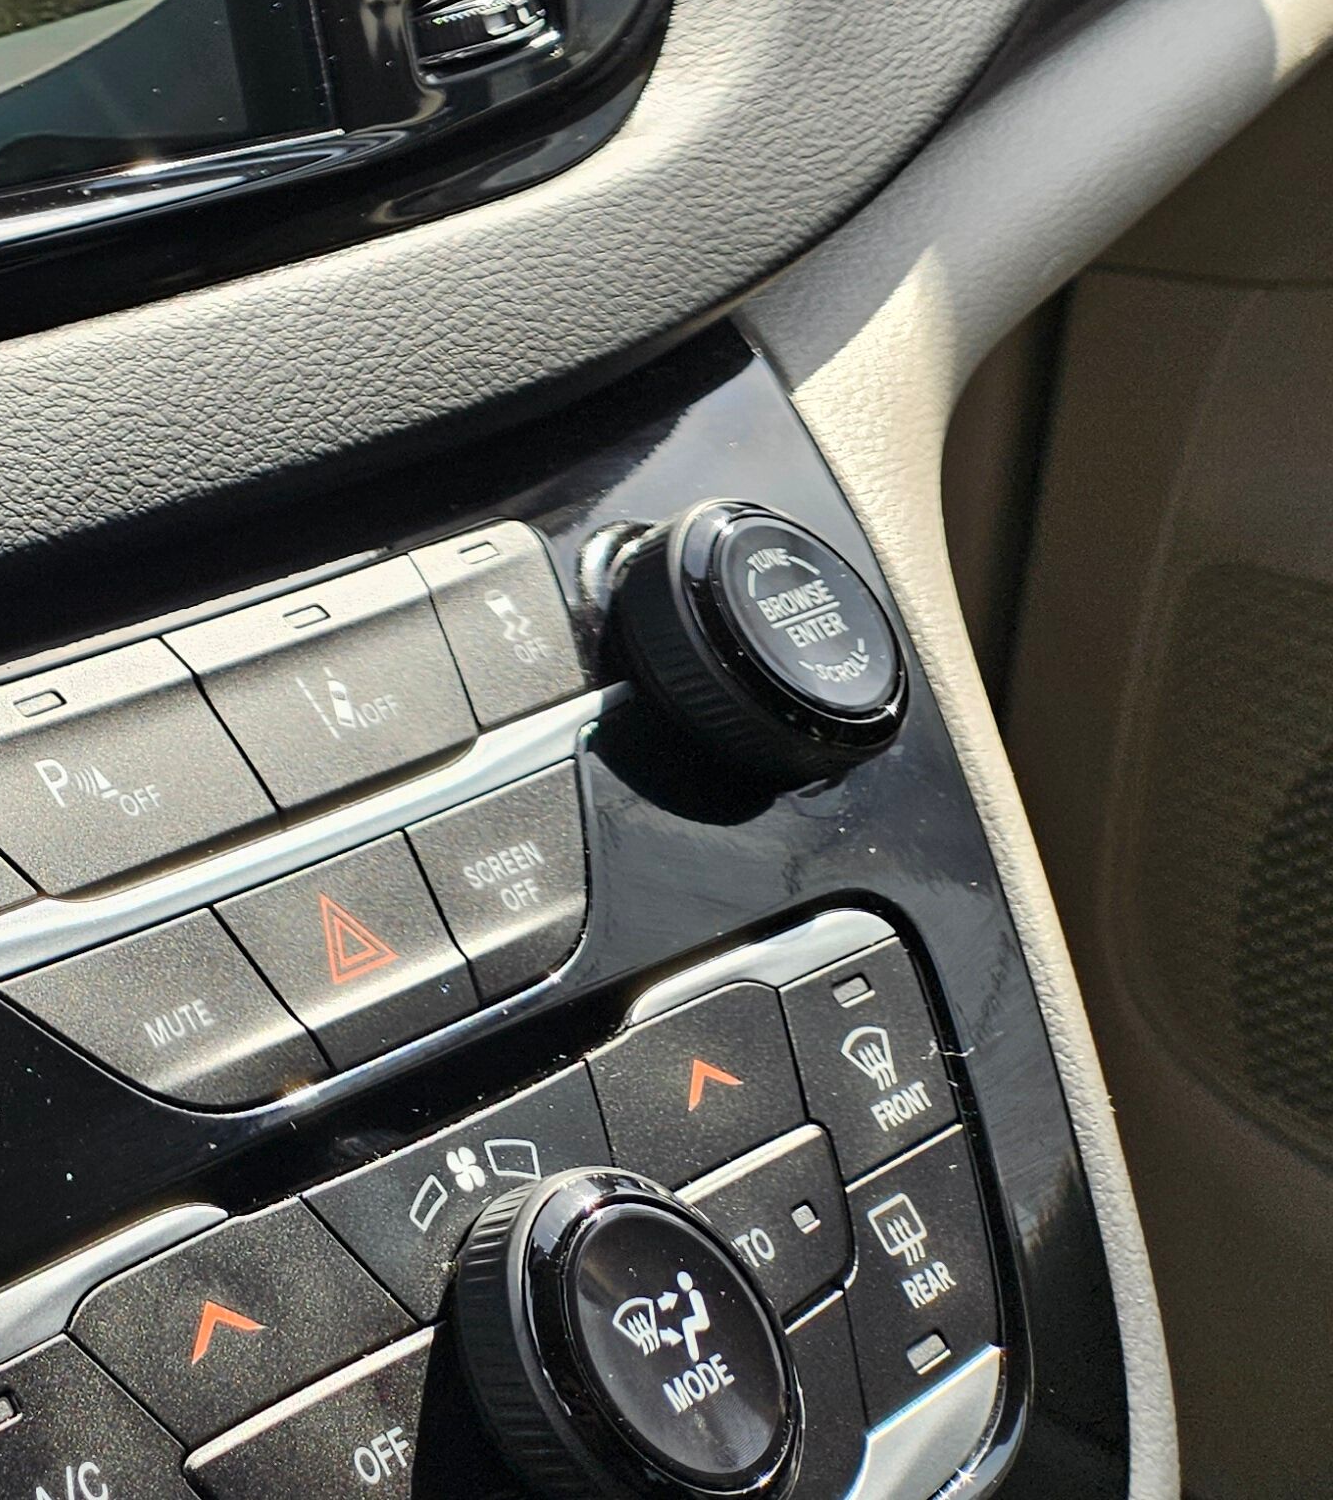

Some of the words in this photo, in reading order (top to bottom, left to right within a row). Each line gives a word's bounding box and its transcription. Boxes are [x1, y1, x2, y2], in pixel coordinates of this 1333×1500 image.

[746, 547, 792, 574] TUNE
[756, 578, 836, 623] BROWSE
[784, 611, 851, 649] ENTER
[513, 638, 550, 664] OFF
[813, 651, 870, 684] SCROLL
[364, 694, 399, 726] OFF
[119, 784, 161, 817] OFF
[461, 840, 547, 891] SCREEN
[500, 878, 542, 913] OFF
[143, 998, 217, 1049] MUTE
[870, 1080, 933, 1132] FRONT
[900, 1260, 957, 1310] REAR
[662, 1352, 736, 1415] MODE
[353, 1425, 411, 1485] OFF
